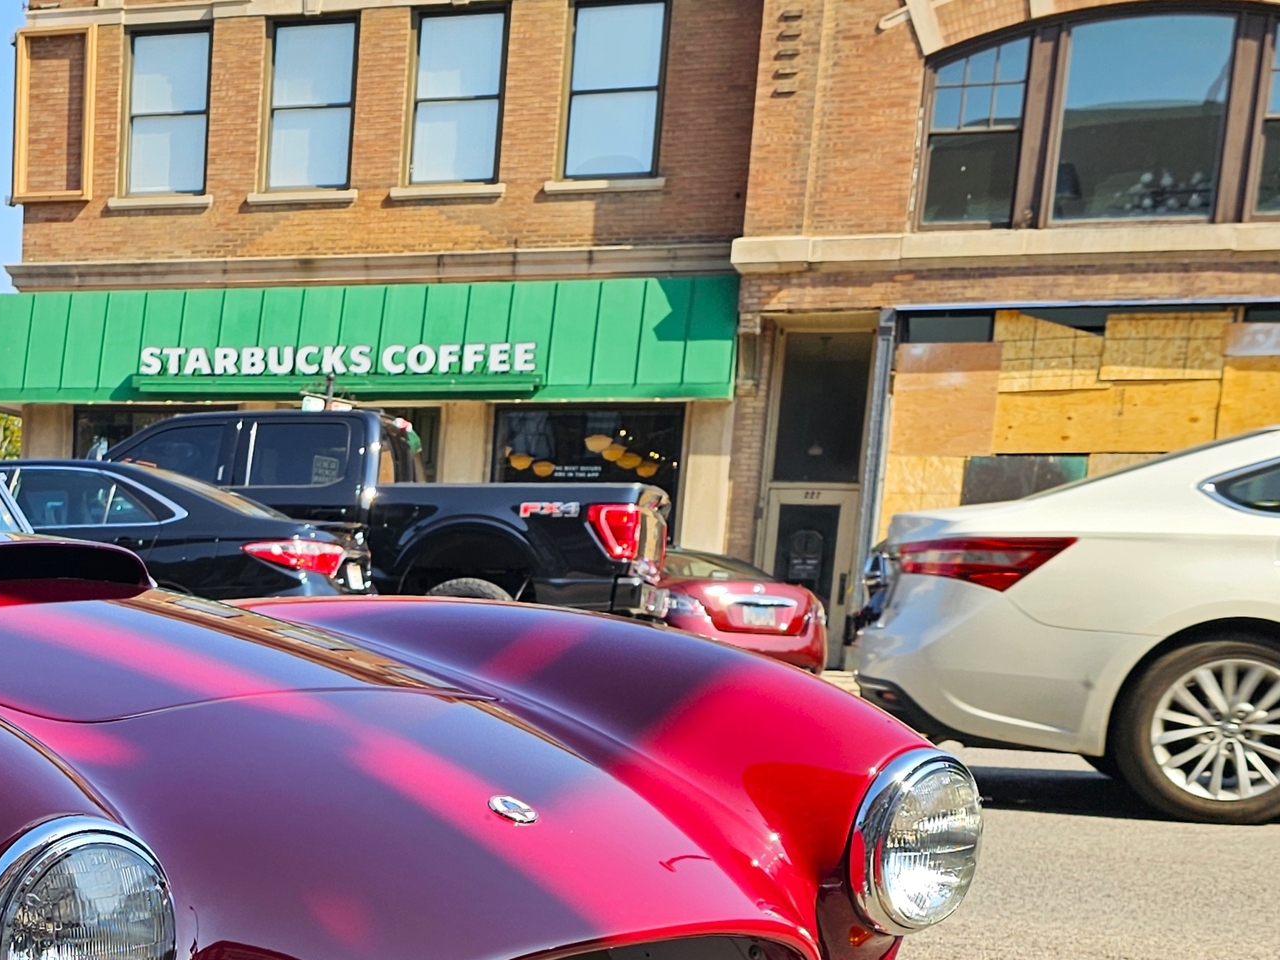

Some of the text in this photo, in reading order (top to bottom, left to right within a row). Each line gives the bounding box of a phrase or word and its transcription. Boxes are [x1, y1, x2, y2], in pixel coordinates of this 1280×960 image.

[140, 341, 538, 376] STARBUCKS COFFEE
[520, 501, 580, 518] FX4
